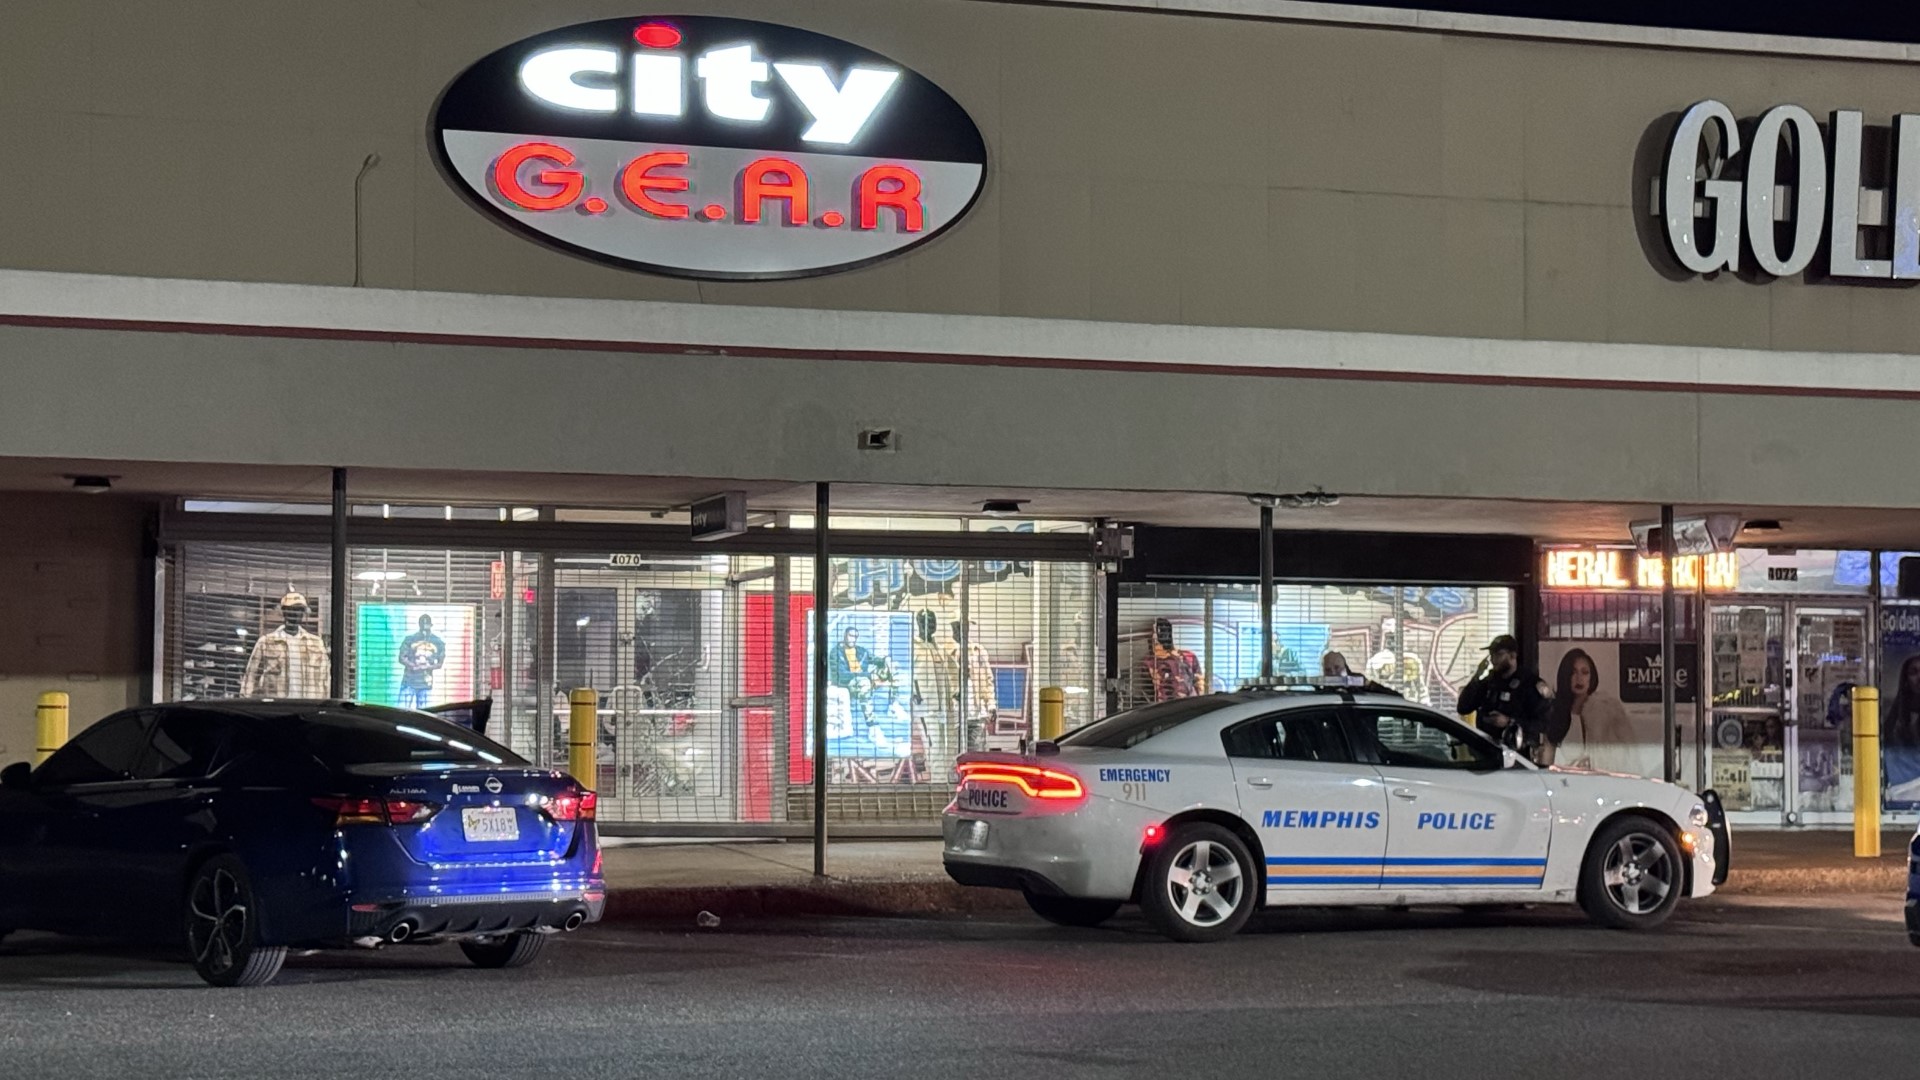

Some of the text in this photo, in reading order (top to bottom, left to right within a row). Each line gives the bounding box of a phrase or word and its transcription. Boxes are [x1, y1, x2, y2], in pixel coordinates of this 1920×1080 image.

[520, 22, 900, 144] city
[493, 142, 925, 232] G.E.A.R
[611, 555, 640, 565] 4070
[1100, 768, 1171, 783] EMERGENCY
[968, 789, 1008, 808] POLICE
[1122, 783, 1147, 801] 911
[1261, 810, 1497, 830] MEMPHIS POLICE
